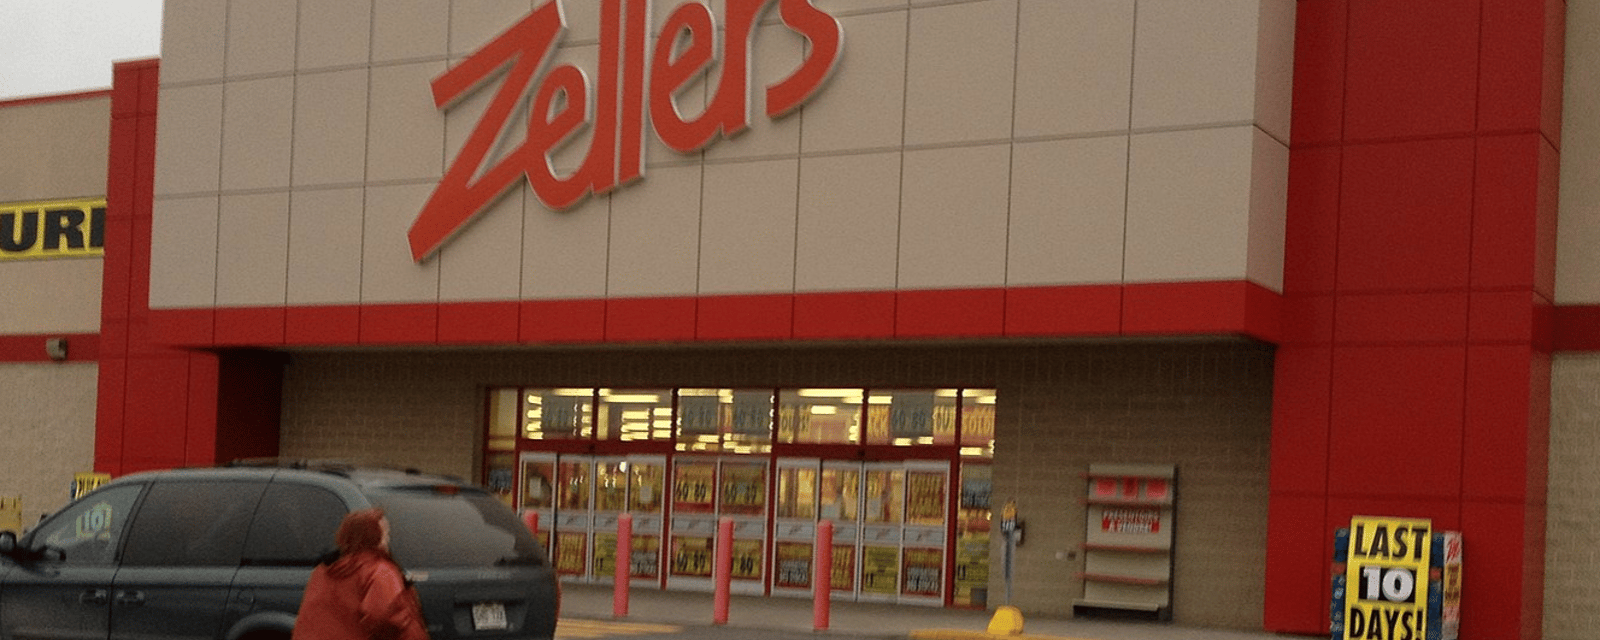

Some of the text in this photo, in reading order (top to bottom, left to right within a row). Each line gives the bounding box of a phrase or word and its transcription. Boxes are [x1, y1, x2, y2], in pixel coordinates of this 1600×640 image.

[407, 0, 845, 264] Zellers
[1354, 525, 1428, 559] LAST
[1363, 565, 1414, 602] 10
[1349, 607, 1424, 640] DAYS!
